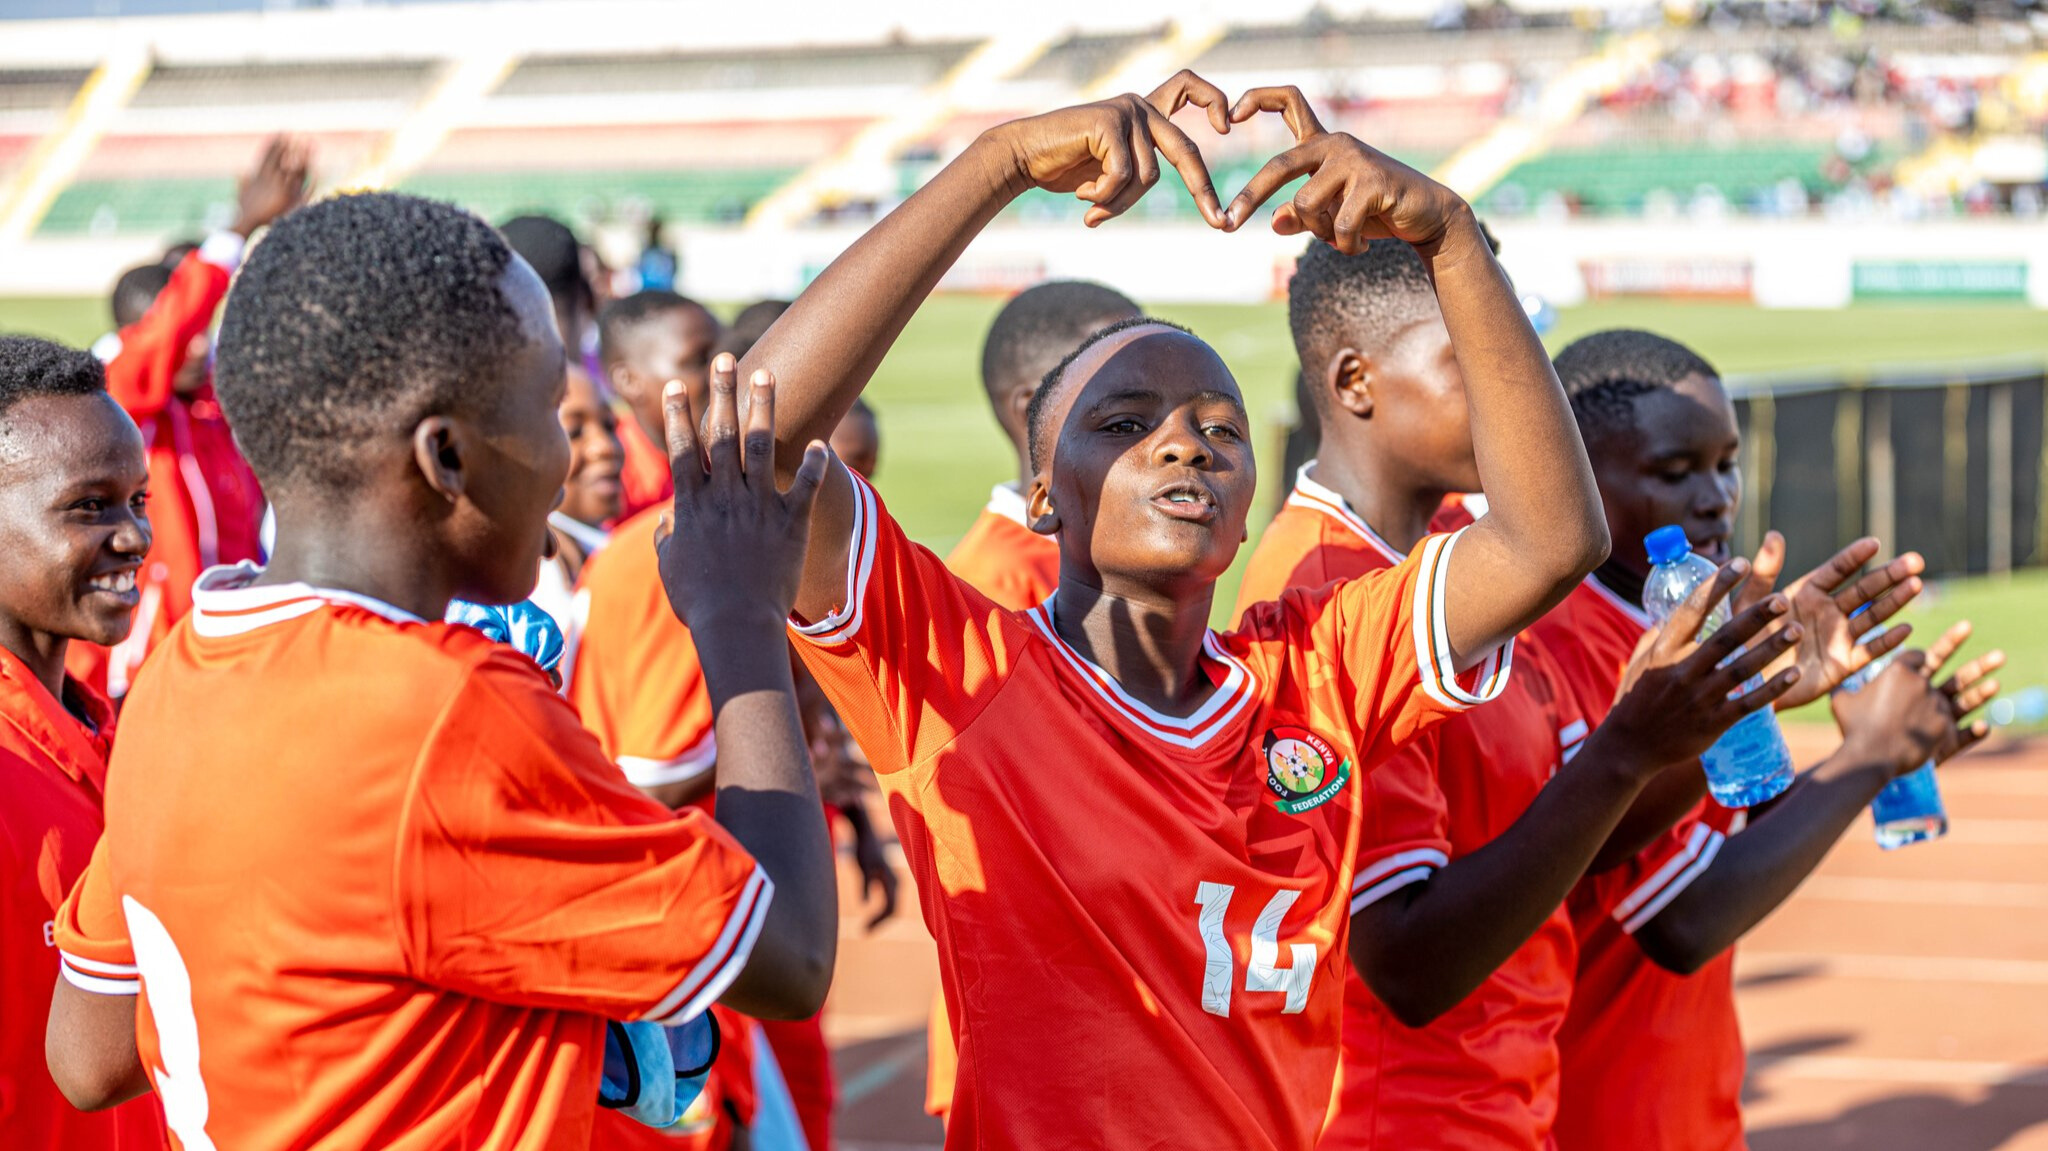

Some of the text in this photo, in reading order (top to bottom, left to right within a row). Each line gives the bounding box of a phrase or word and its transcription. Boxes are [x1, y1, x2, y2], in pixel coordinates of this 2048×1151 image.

[1306, 735, 1334, 765] KENYA
[1291, 776, 1345, 812] FEDERATION
[1194, 881, 1317, 1018] 14
